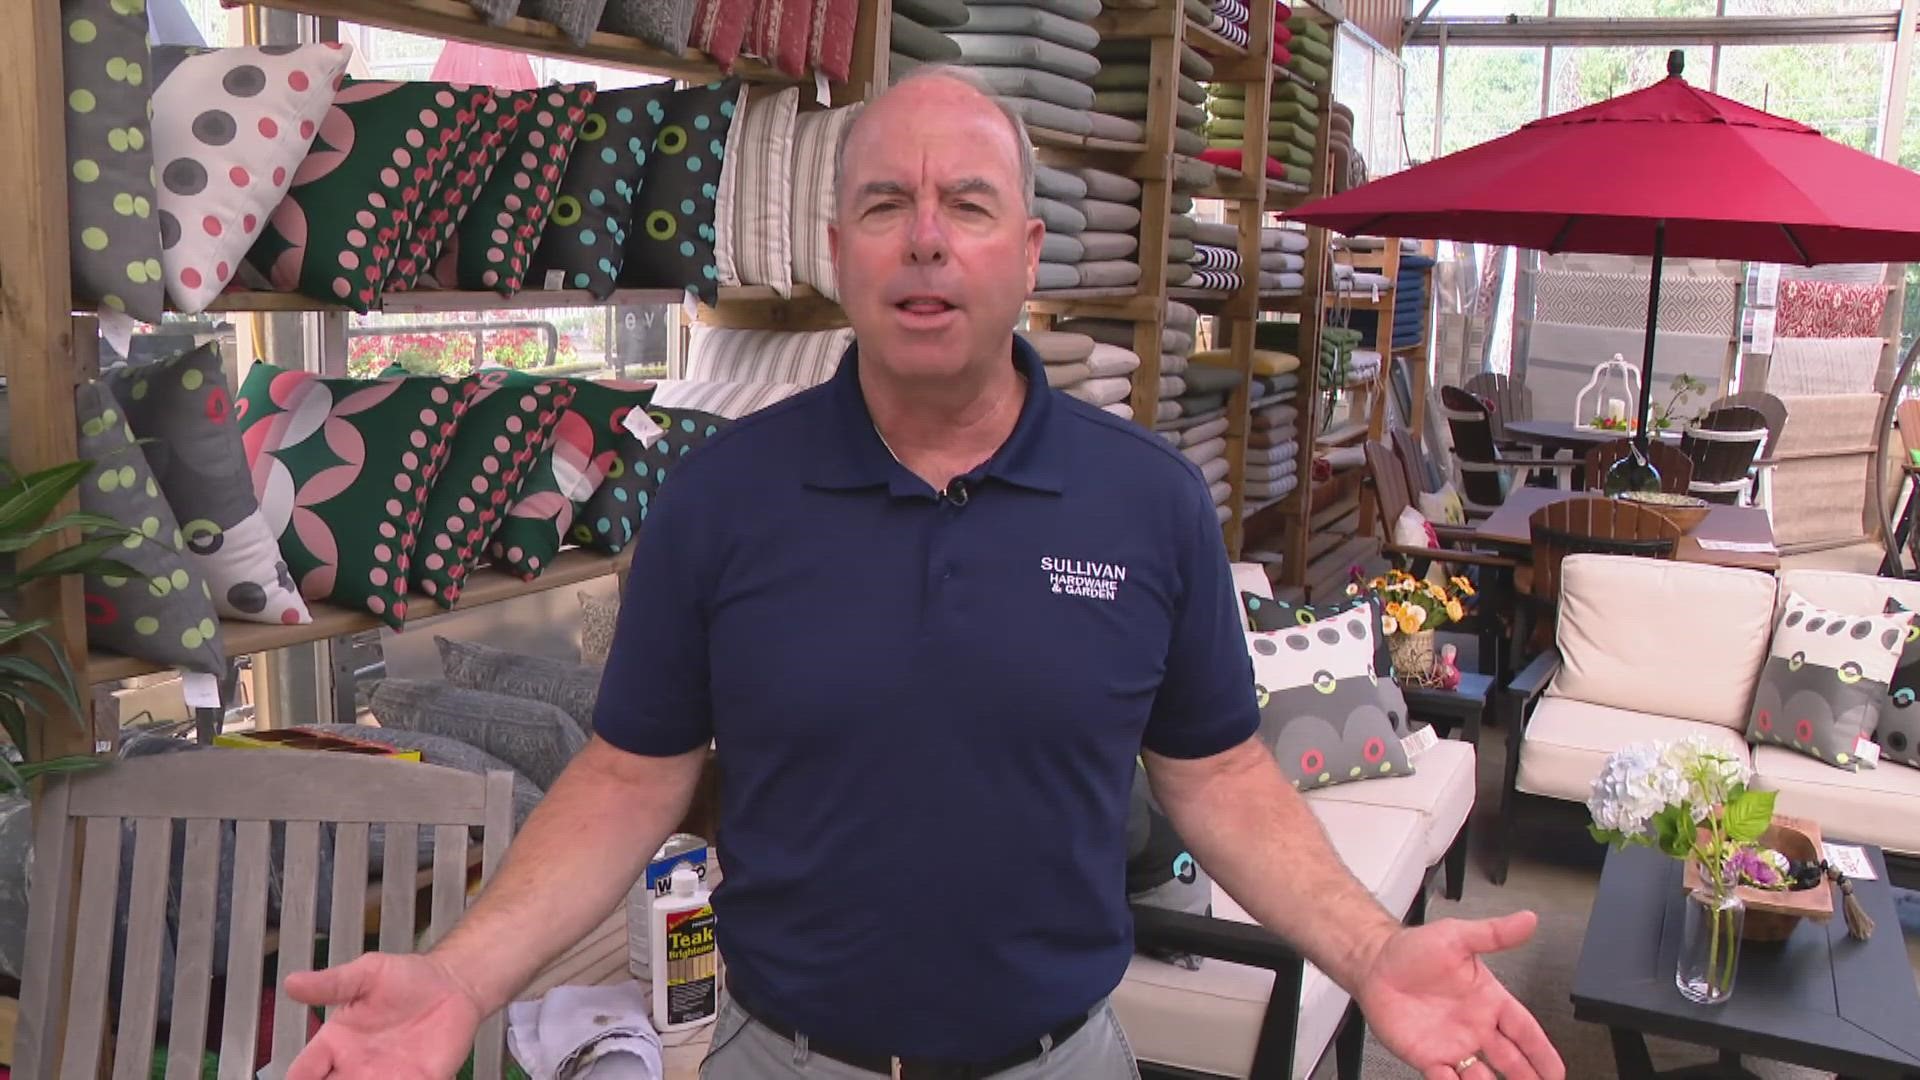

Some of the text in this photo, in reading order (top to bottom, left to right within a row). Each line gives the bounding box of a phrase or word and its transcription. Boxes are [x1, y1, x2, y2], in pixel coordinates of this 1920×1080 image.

[1041, 556, 1126, 582] SULLIVAN
[1050, 573, 1118, 590] HARDWARE
[1051, 583, 1115, 600] & GARDEN
[669, 927, 713, 949] Teak
